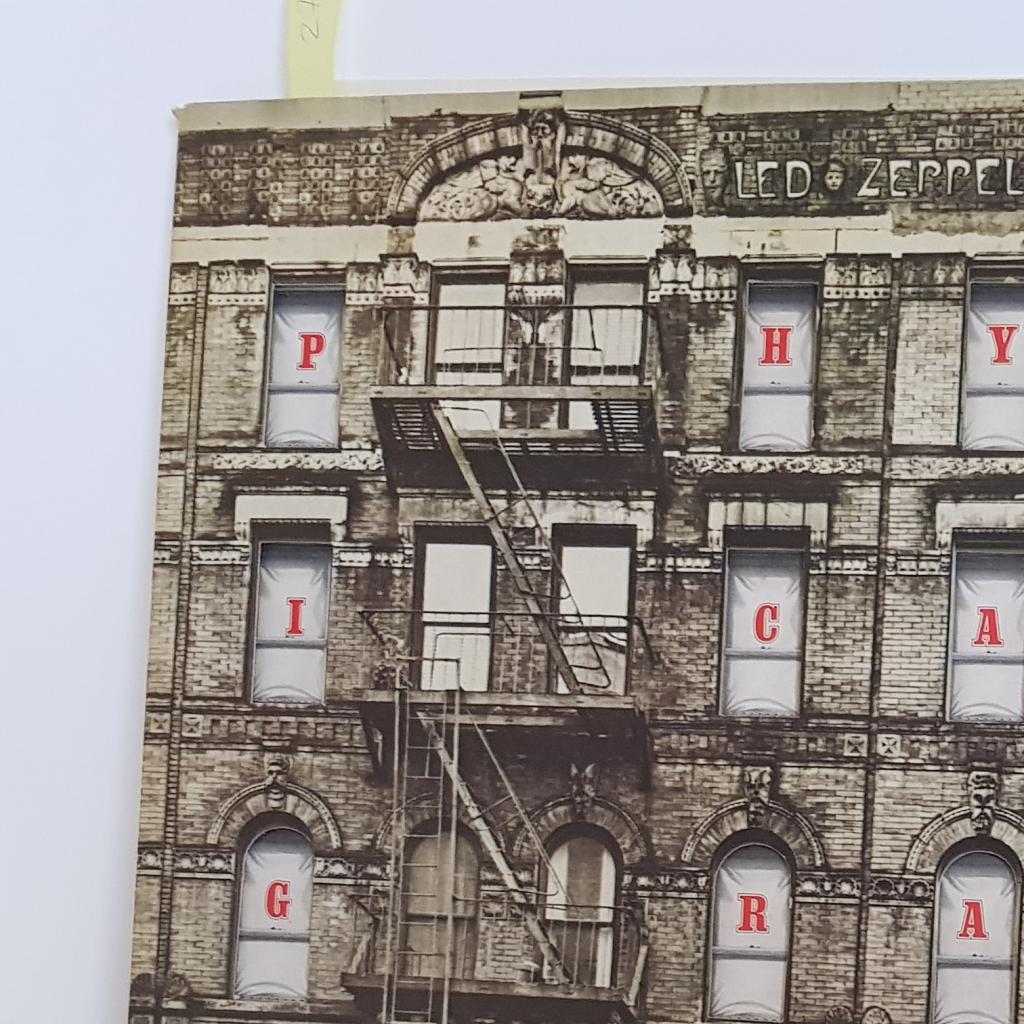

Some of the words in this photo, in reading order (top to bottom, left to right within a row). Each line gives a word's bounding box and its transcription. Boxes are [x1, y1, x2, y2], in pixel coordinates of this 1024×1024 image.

[734, 159, 813, 200] LED
[298, 333, 326, 370] P
[760, 326, 793, 366] H
[987, 325, 1019, 365] Y
[286, 598, 305, 636] I
[753, 604, 780, 643] C
[972, 607, 1004, 647] A
[264, 881, 291, 920] G
[735, 894, 770, 934] R
[956, 900, 988, 940] A
